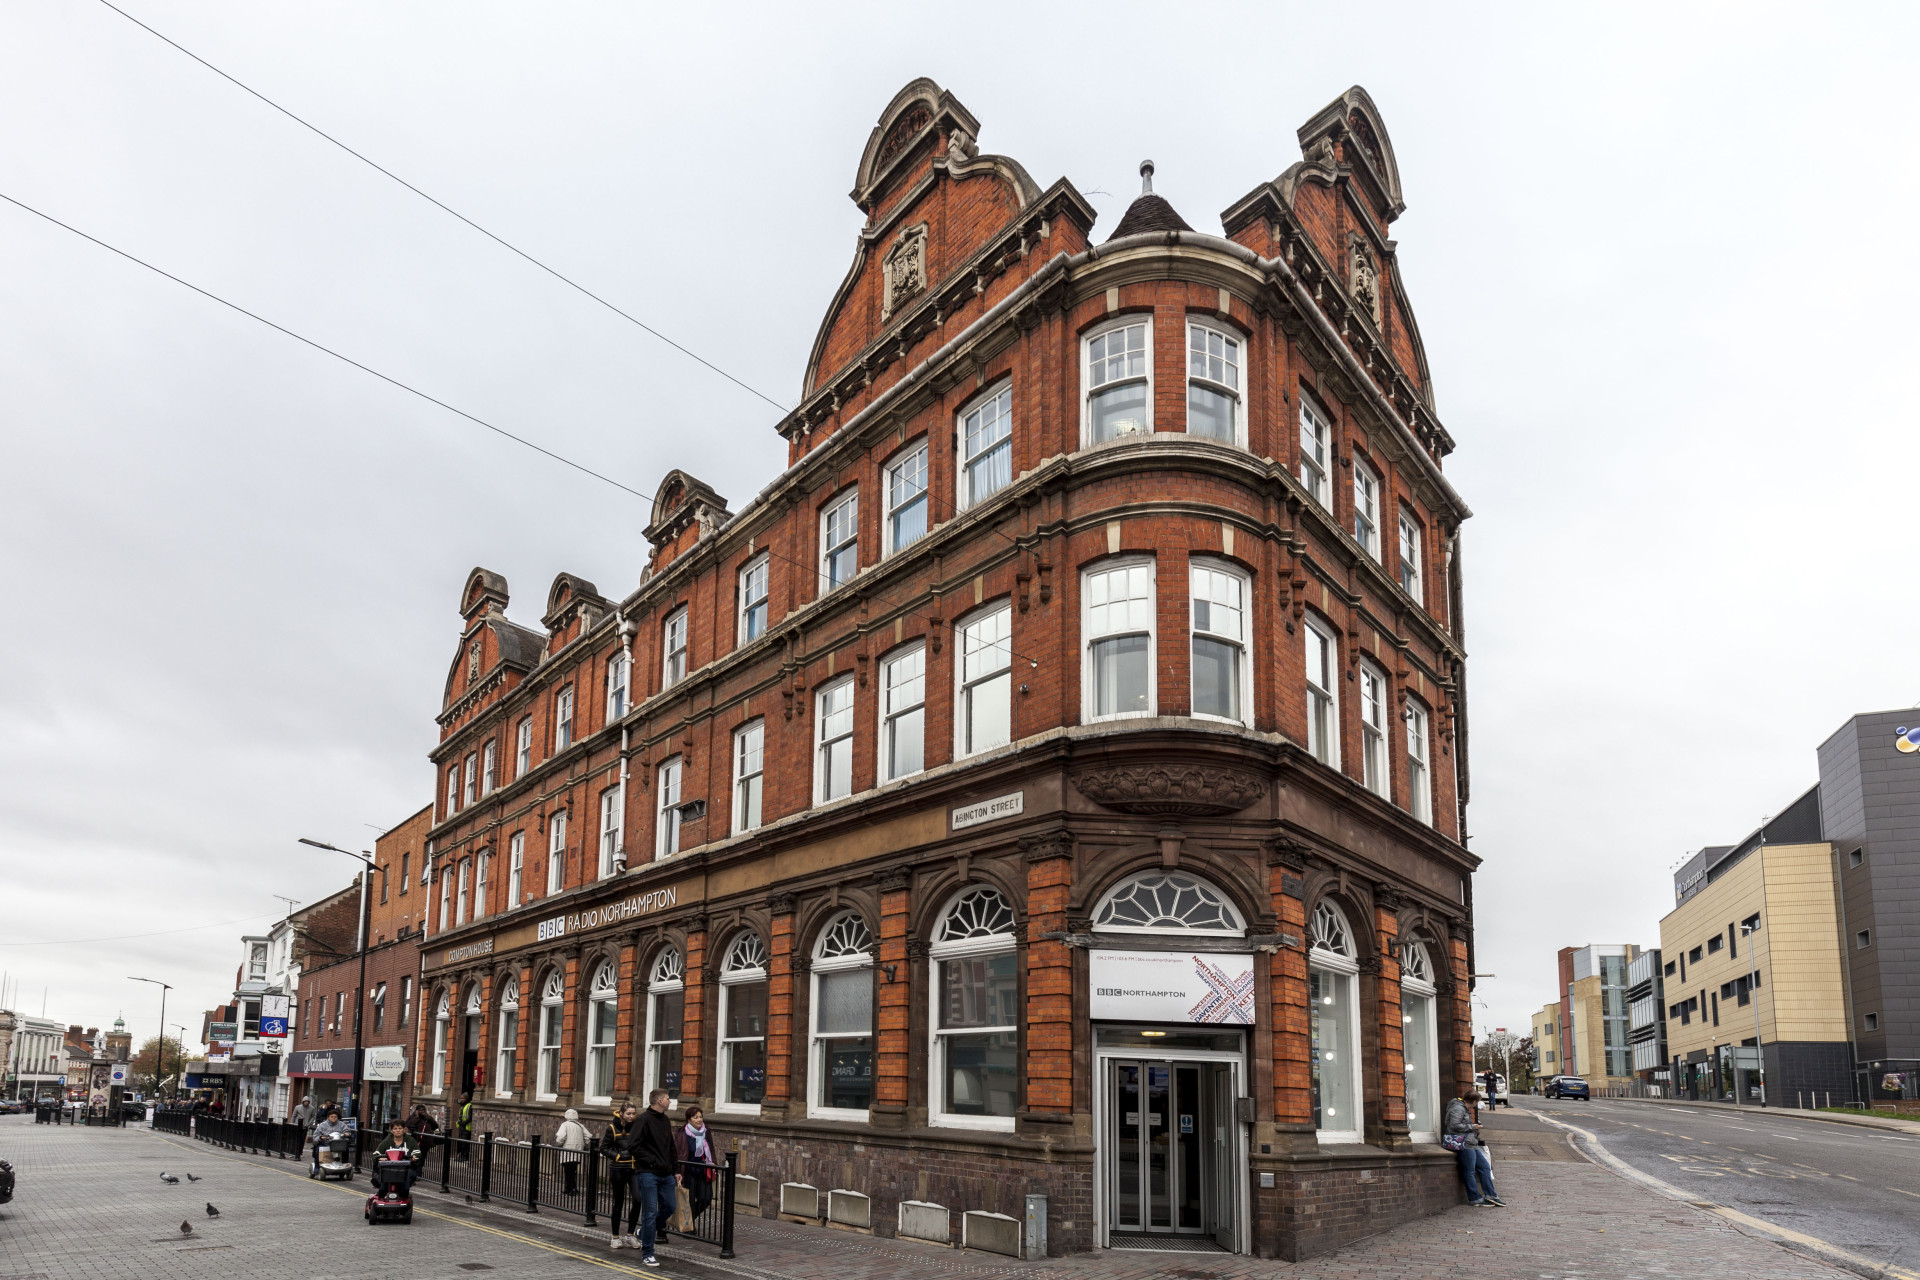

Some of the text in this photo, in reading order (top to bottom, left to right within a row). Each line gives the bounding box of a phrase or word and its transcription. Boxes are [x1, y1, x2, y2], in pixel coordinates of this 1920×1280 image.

[991, 798, 1020, 814] STREET
[538, 886, 676, 941] BBC RADIO NORTHAMPTON
[449, 939, 493, 962] COMPTON HOUSE
[1192, 955, 1236, 1000] NORTHAMPTON
[1195, 970, 1219, 995] THRAPSTON
[1211, 963, 1238, 989] SILVERSTONE
[1237, 975, 1255, 994] RUSHDE
[1097, 988, 1186, 998] BBC NORTHAMPTON
[1188, 991, 1213, 1015] TOWCESTER
[1194, 993, 1223, 1022] DAVENTRY
[309, 1053, 333, 1072] Nationwide
